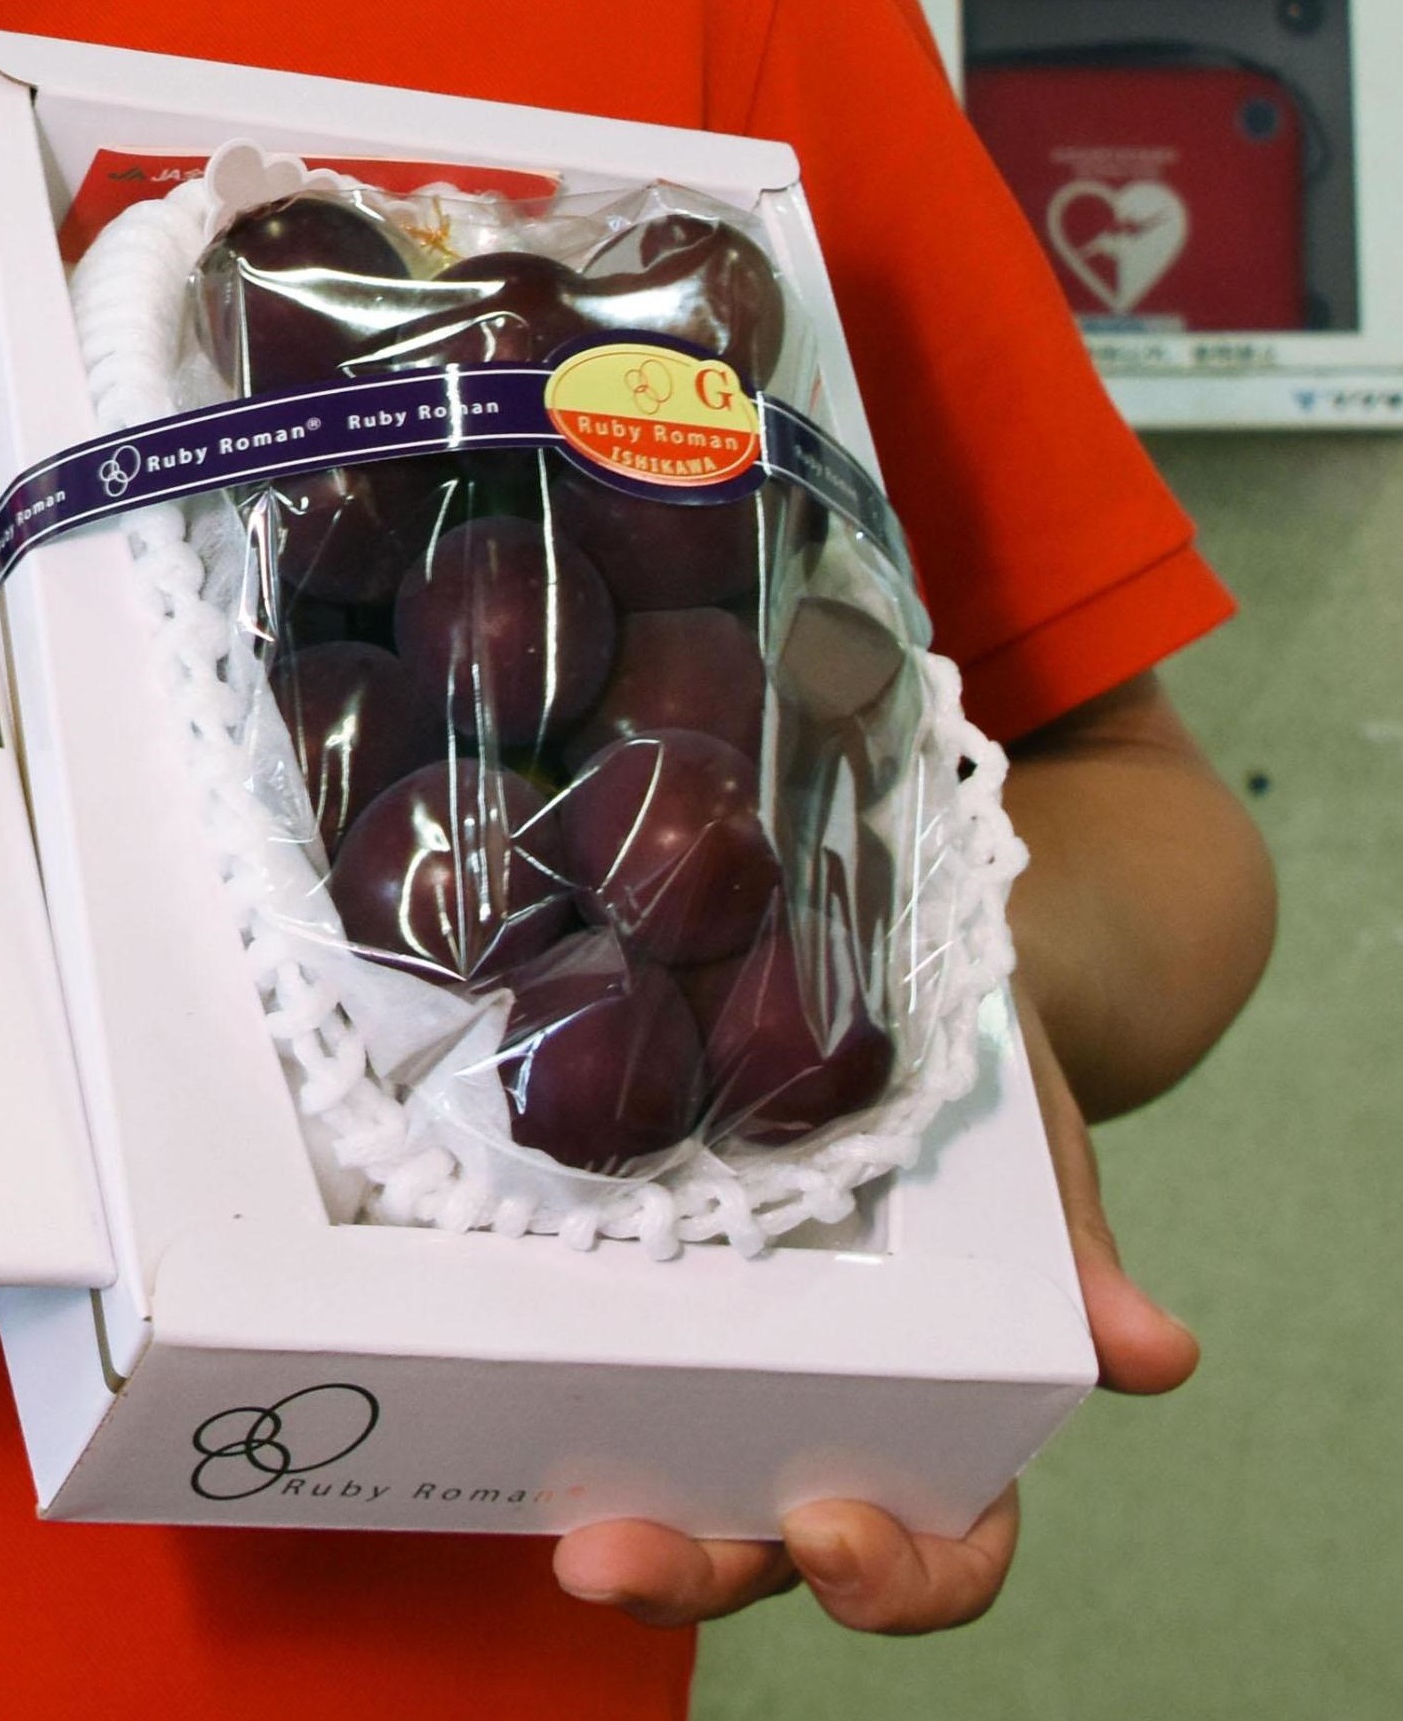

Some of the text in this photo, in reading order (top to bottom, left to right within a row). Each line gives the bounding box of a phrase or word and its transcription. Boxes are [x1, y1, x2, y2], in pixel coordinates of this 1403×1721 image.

[695, 368, 733, 411] G
[577, 416, 739, 452] Ruby Roman
[15, 490, 66, 526] Roman
[147, 444, 208, 472] Ruby
[347, 409, 407, 431] Ruby
[611, 446, 717, 475] ISHIKAWA
[281, 1479, 555, 1503] Ruby Roman
